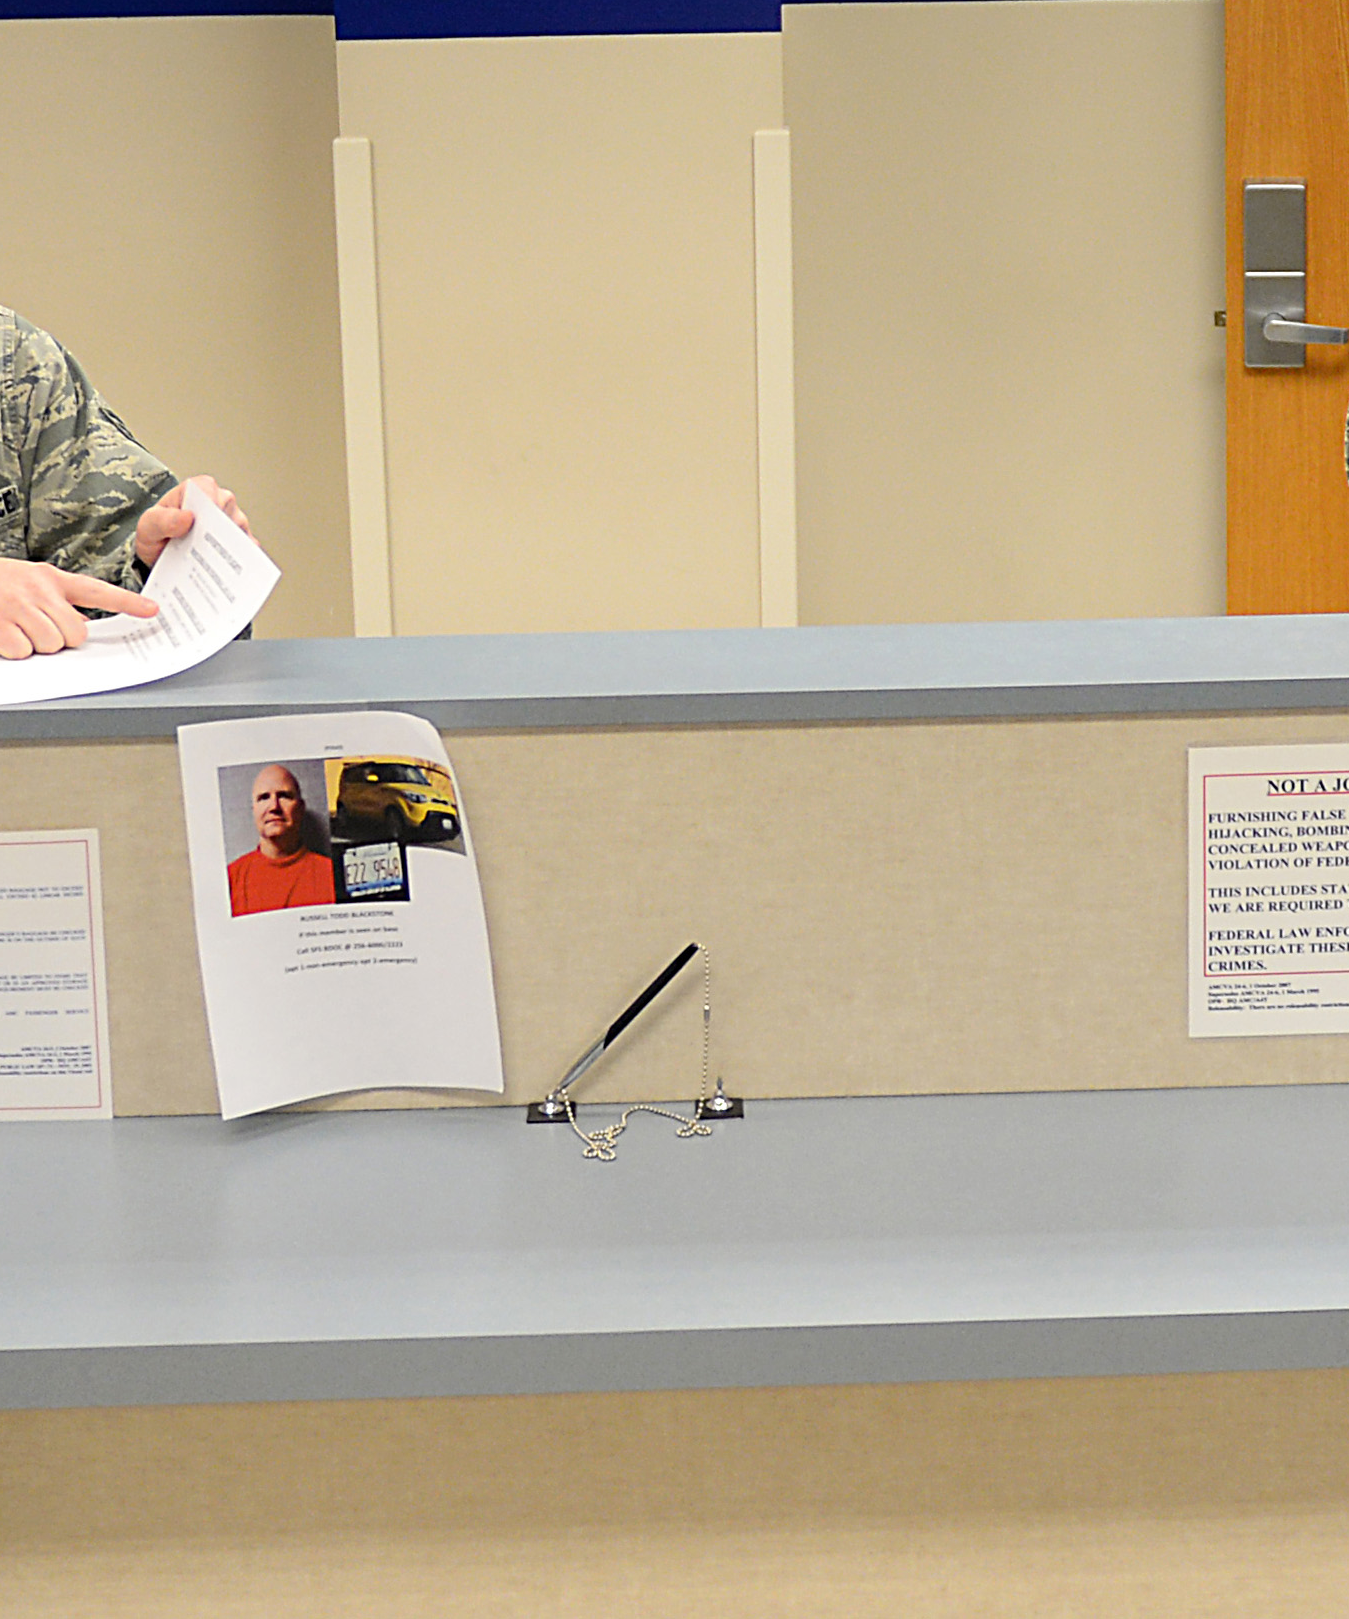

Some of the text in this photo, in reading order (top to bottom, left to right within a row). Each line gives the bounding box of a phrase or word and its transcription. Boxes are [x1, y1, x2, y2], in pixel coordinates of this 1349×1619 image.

[1267, 779, 1304, 794] NOT
[1315, 779, 1326, 792] A
[1208, 811, 1297, 823] FURNISHING
[1301, 809, 1345, 820] FALSE
[1208, 826, 1292, 839] HIJACKING,
[1208, 842, 1297, 854] CONCEALED
[1209, 858, 1289, 870] VIOLATION
[1293, 857, 1311, 867] OF
[1210, 887, 1241, 898] THIS
[1245, 884, 1317, 896] INCLUDES
[1209, 903, 1230, 913] WE
[1236, 902, 1263, 912] ARE
[1268, 899, 1343, 913] REQUIRED
[1208, 929, 1273, 940] FEDERAL
[1279, 928, 1310, 938] LAW
[1208, 943, 1304, 955] INVESTIGATE
[1208, 960, 1267, 971] CRIMES.
